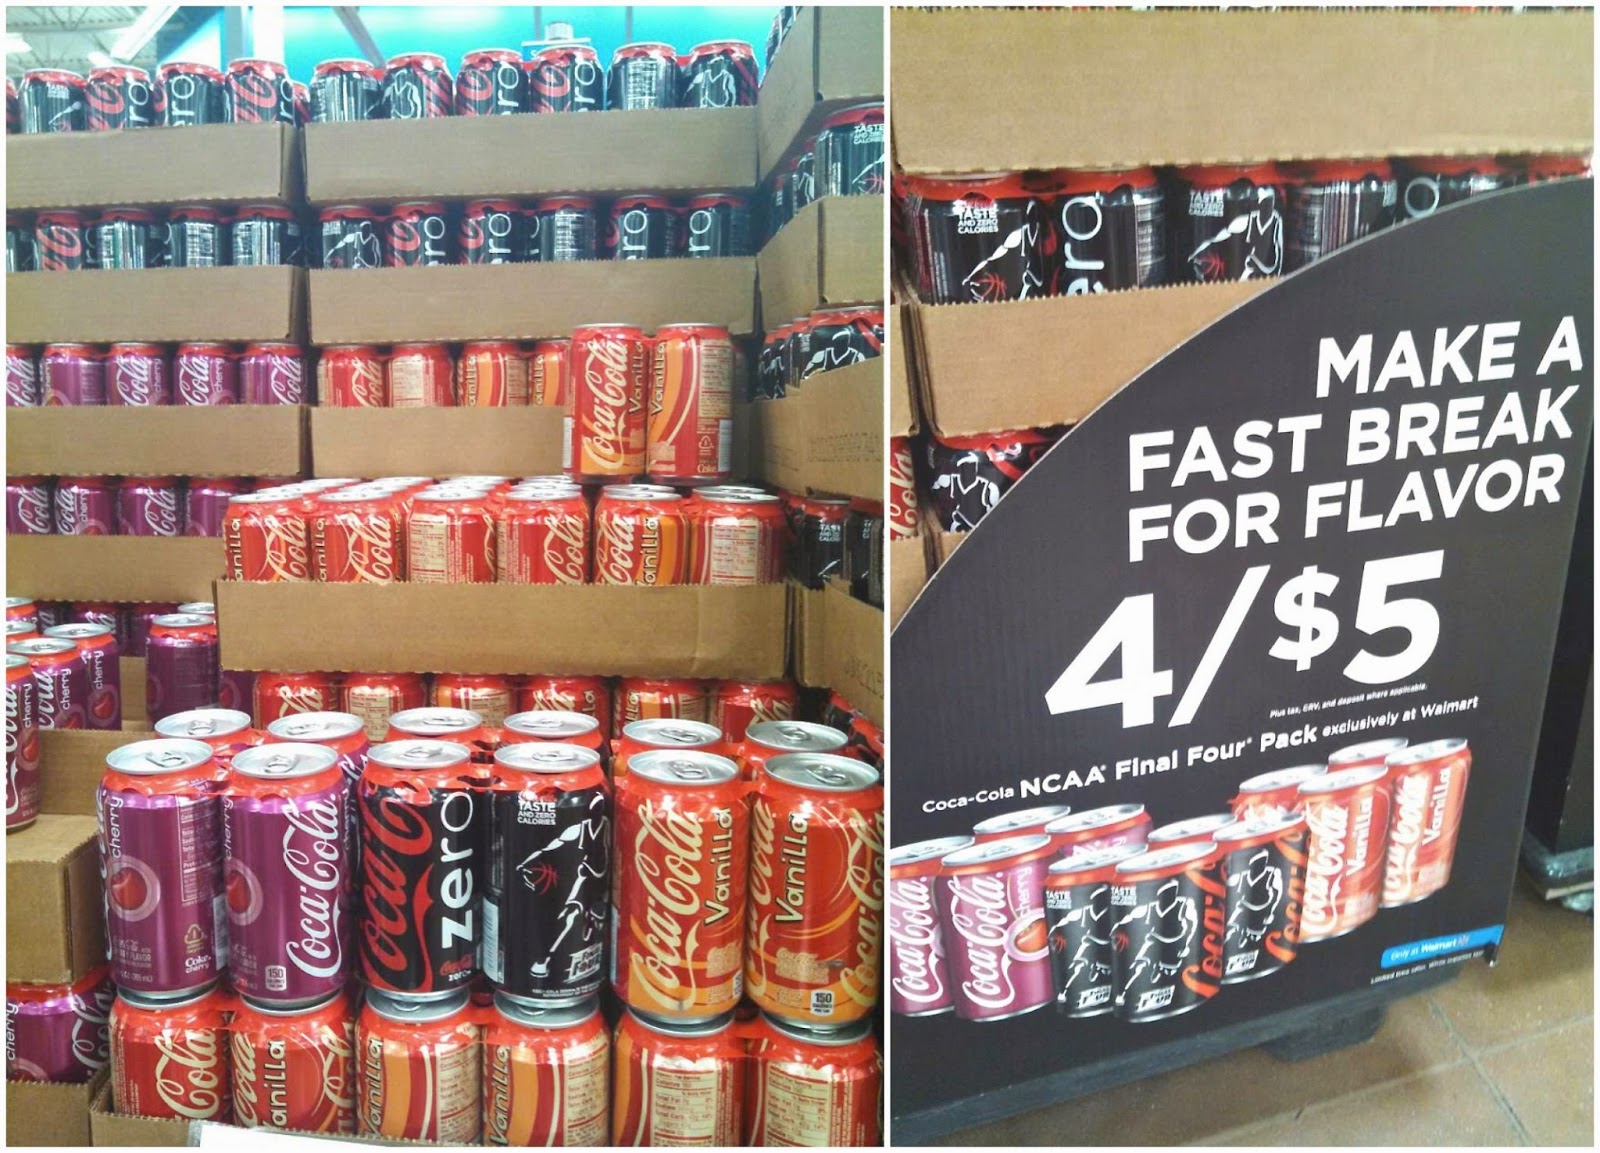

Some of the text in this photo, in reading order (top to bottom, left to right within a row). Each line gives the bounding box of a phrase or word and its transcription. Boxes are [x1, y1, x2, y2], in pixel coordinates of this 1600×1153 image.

[628, 341, 643, 413] Vanilla
[650, 342, 666, 415] Vanilla
[1315, 316, 1583, 398] MAKE A
[582, 338, 628, 469] Coca-Cola
[1129, 385, 1580, 492] FAST BREAK
[1129, 453, 1565, 562] FOR FLAVOR
[1045, 549, 1445, 728] 4/$5
[22, 683, 33, 729] cherry
[61, 668, 71, 710] cherry
[922, 787, 1014, 813] Coca-Cola
[1115, 750, 1178, 780] Final
[1260, 723, 1317, 752] Pack
[1322, 711, 1399, 737] exclusively
[1402, 708, 1416, 722] at
[1421, 695, 1479, 718] Walmart
[109, 796, 124, 859] cherry
[223, 795, 234, 859] cherry
[517, 817, 556, 825] CALORIES
[518, 801, 556, 812] TASTE
[1346, 797, 1374, 877] Vanilla
[1422, 767, 1451, 845] Vanilla
[283, 792, 342, 978] Coca-Cola
[441, 792, 473, 949] zero
[632, 799, 703, 1011] Coca-Cola
[704, 808, 732, 925] Vanilla
[775, 812, 810, 923] Vanilla
[948, 872, 1016, 1008] Coca-Cola
[7, 1003, 19, 1061] cherry
[815, 993, 832, 1003] 150
